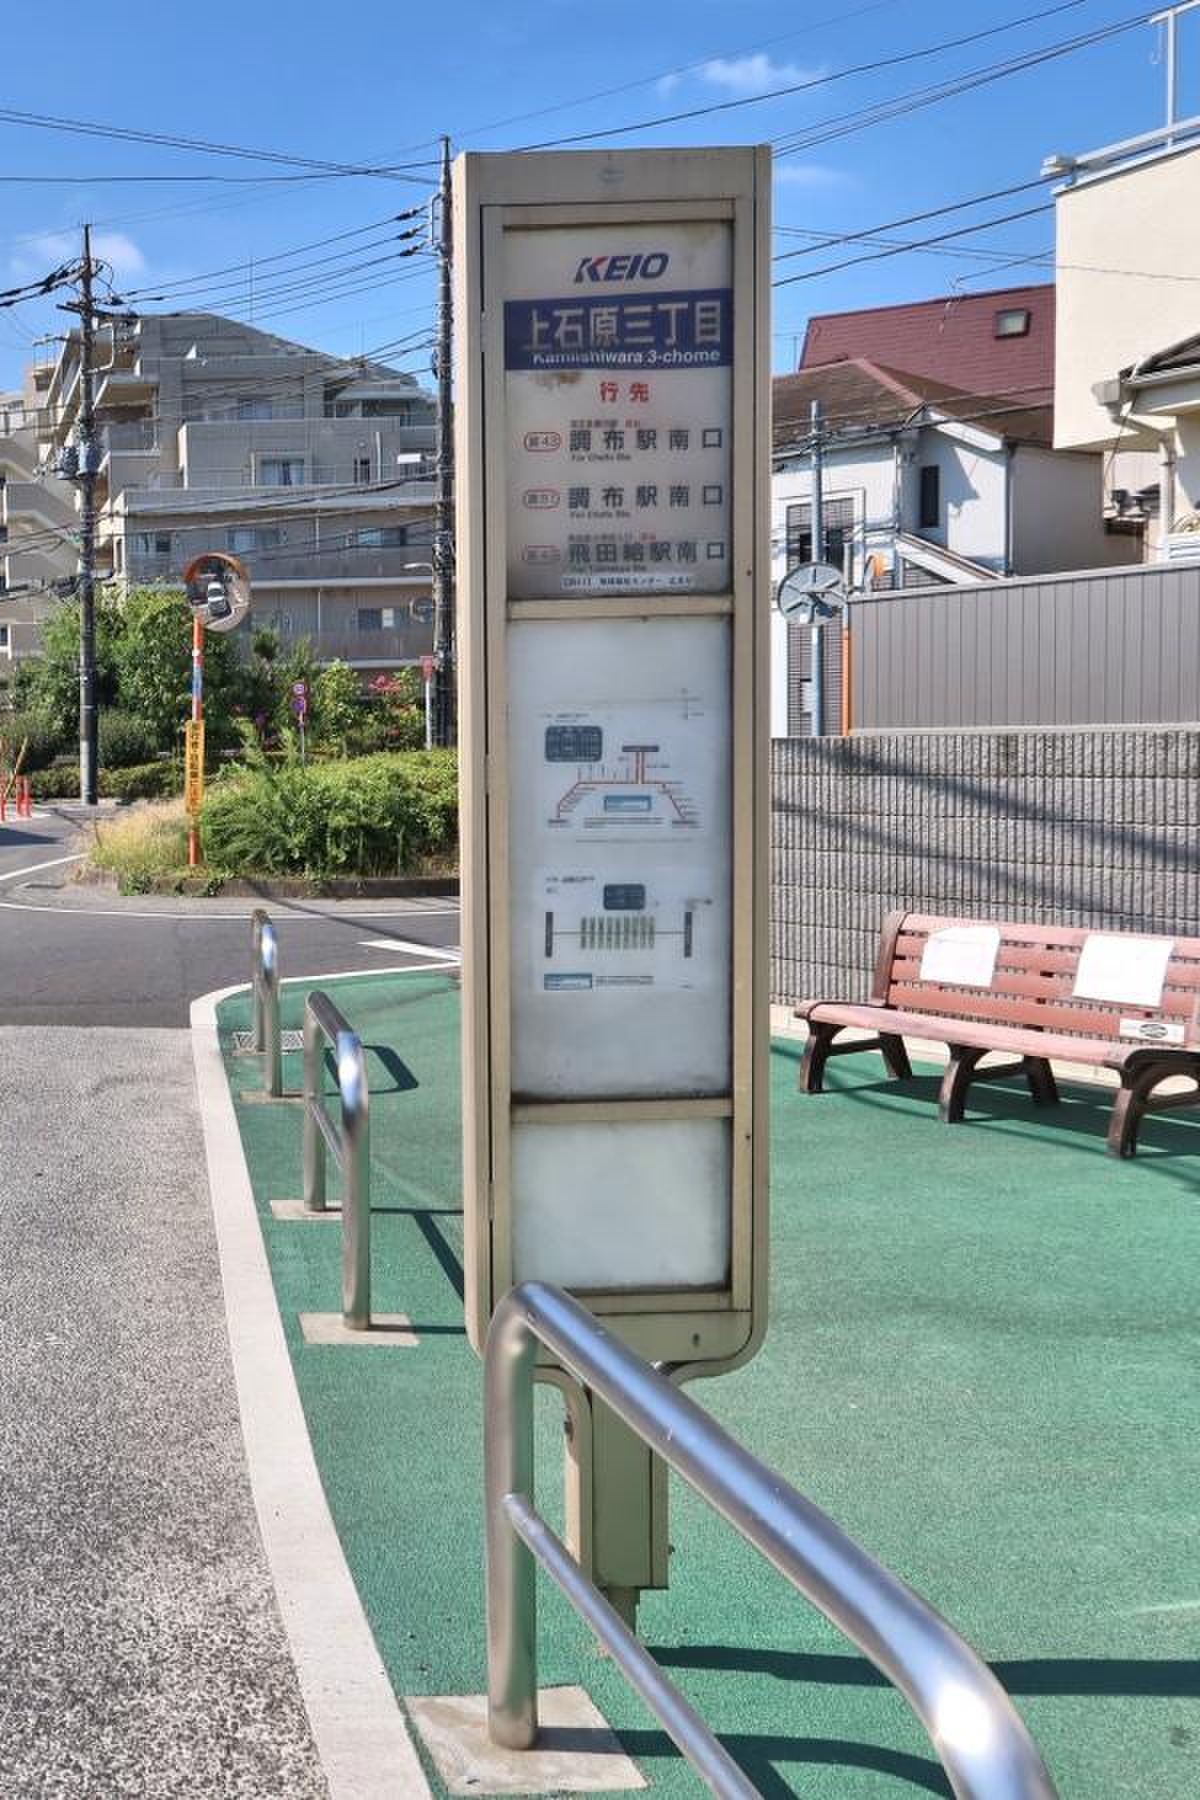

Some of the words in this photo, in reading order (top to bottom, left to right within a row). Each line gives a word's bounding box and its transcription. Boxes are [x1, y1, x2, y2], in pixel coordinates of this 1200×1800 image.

[574, 253, 669, 283] KEIO
[523, 301, 721, 351] 上石原三丁目
[647, 347, 721, 364] 3-chome
